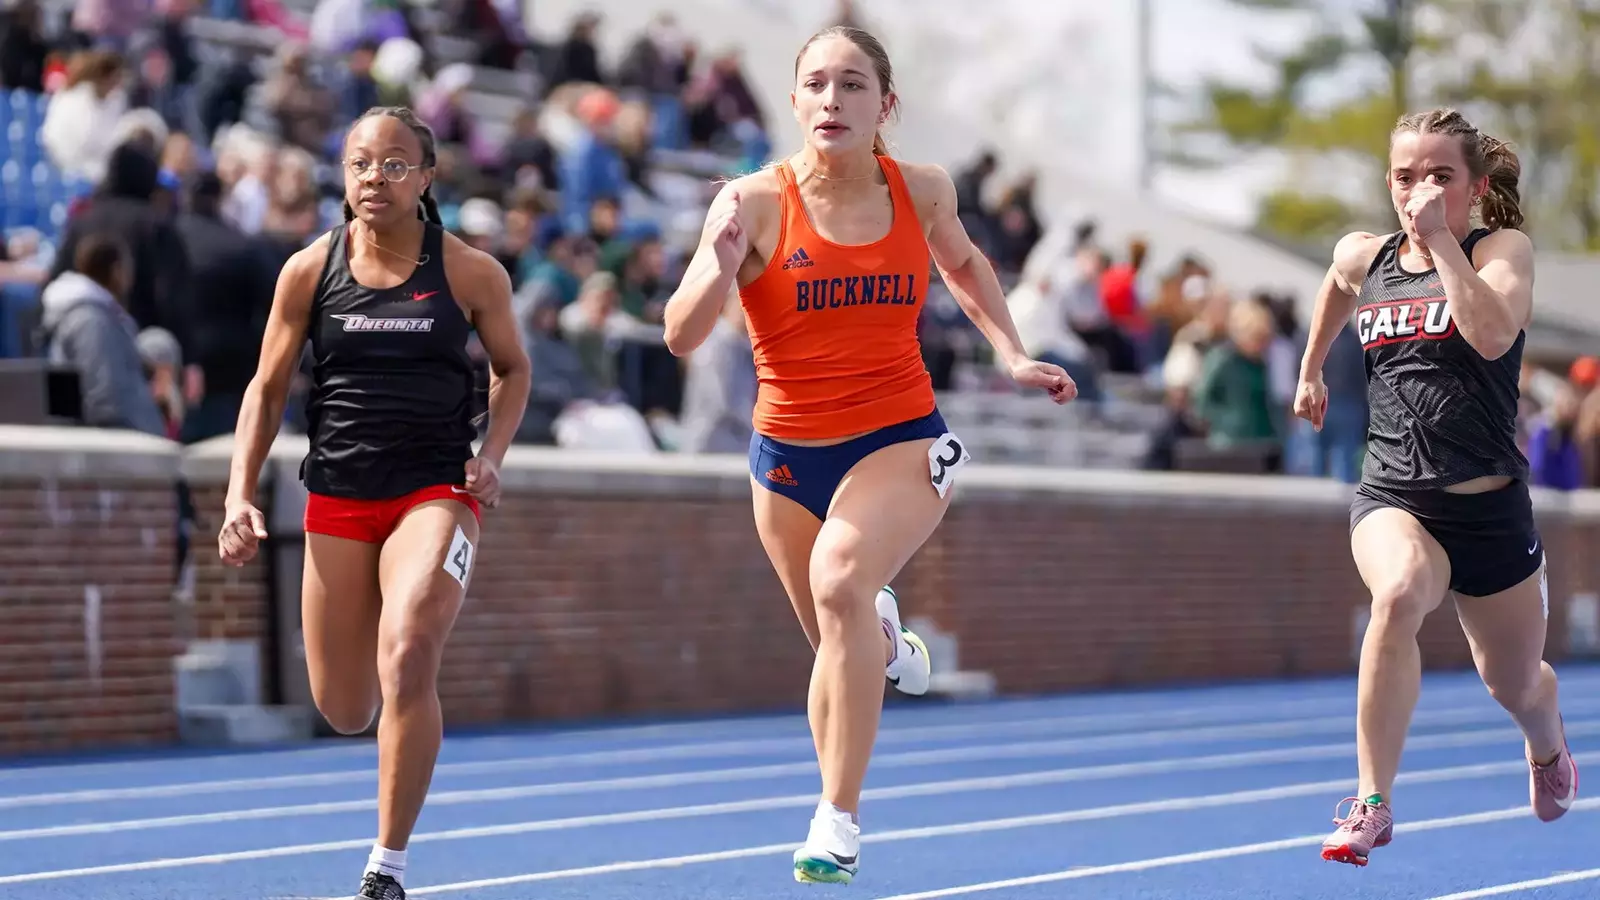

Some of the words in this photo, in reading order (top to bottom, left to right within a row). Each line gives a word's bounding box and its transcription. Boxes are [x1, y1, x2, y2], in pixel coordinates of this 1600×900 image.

[782, 259, 814, 270] adidas
[796, 274, 917, 312] BUCKNELL
[343, 314, 434, 332] ONEONTA
[932, 438, 962, 485] 3
[765, 470, 798, 486] adidas
[453, 540, 469, 581] 4
